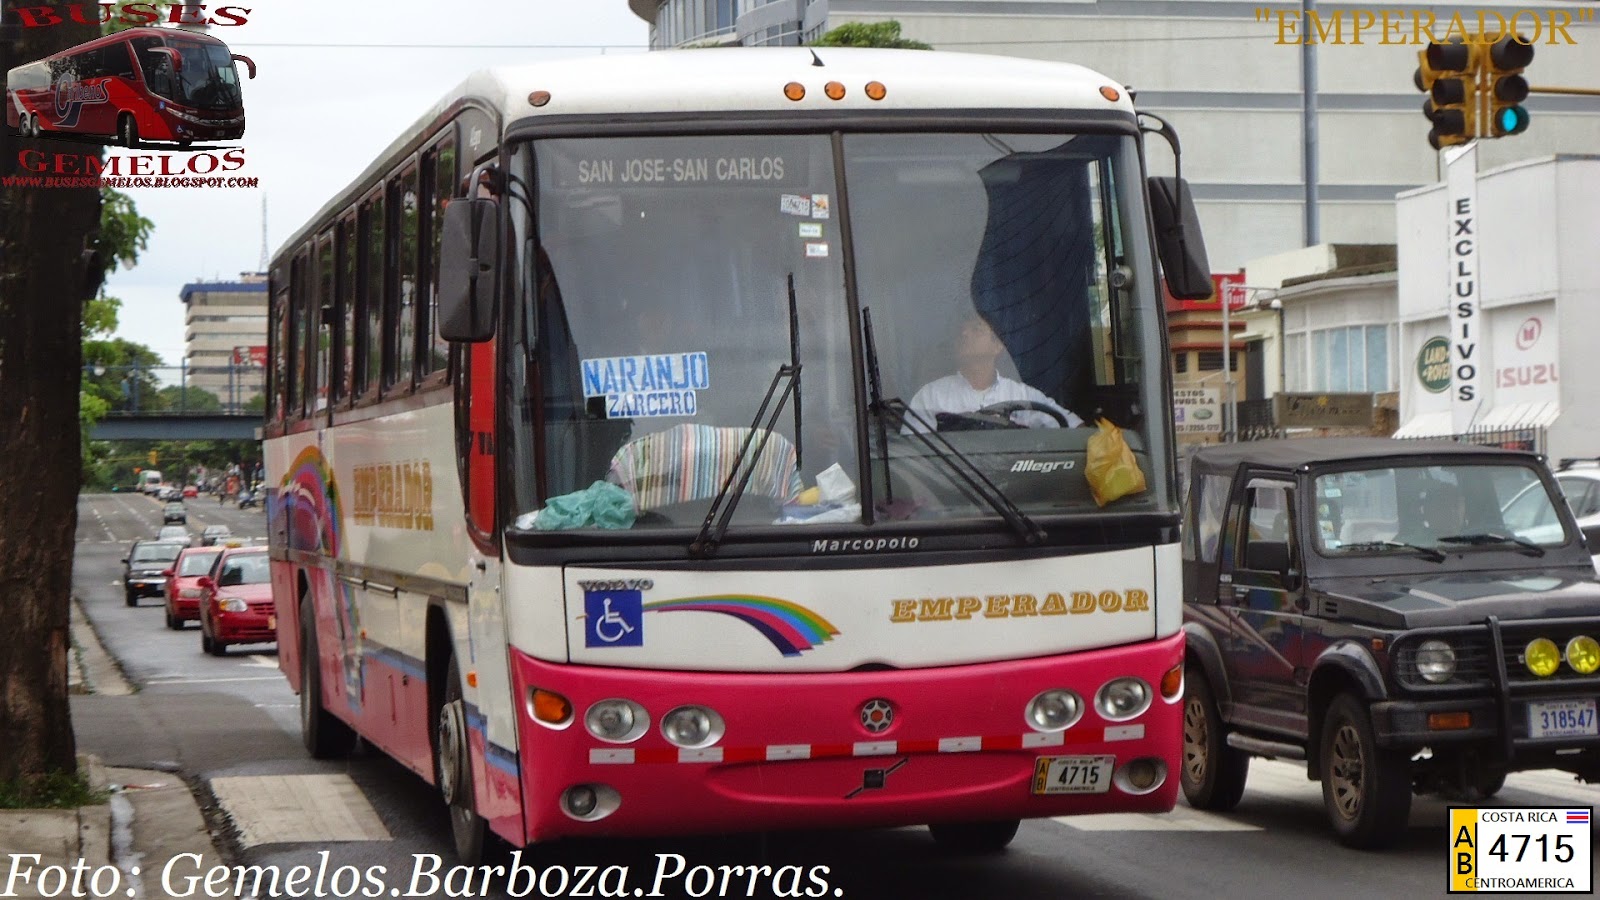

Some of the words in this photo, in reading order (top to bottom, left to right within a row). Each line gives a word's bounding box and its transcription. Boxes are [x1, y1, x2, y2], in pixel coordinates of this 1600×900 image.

[578, 160, 613, 183] SAN
[716, 157, 785, 180] CARLOS
[1455, 198, 1476, 401] EXCLUSIVOS
[583, 353, 709, 396] NARANJO
[608, 391, 696, 417] ZARCERO
[1010, 459, 1076, 473] Allegro
[812, 536, 920, 553] Marcopolo
[890, 588, 1150, 623] EMPERADOR
[1541, 709, 1594, 729] 318547
[1058, 766, 1100, 785] 4715
